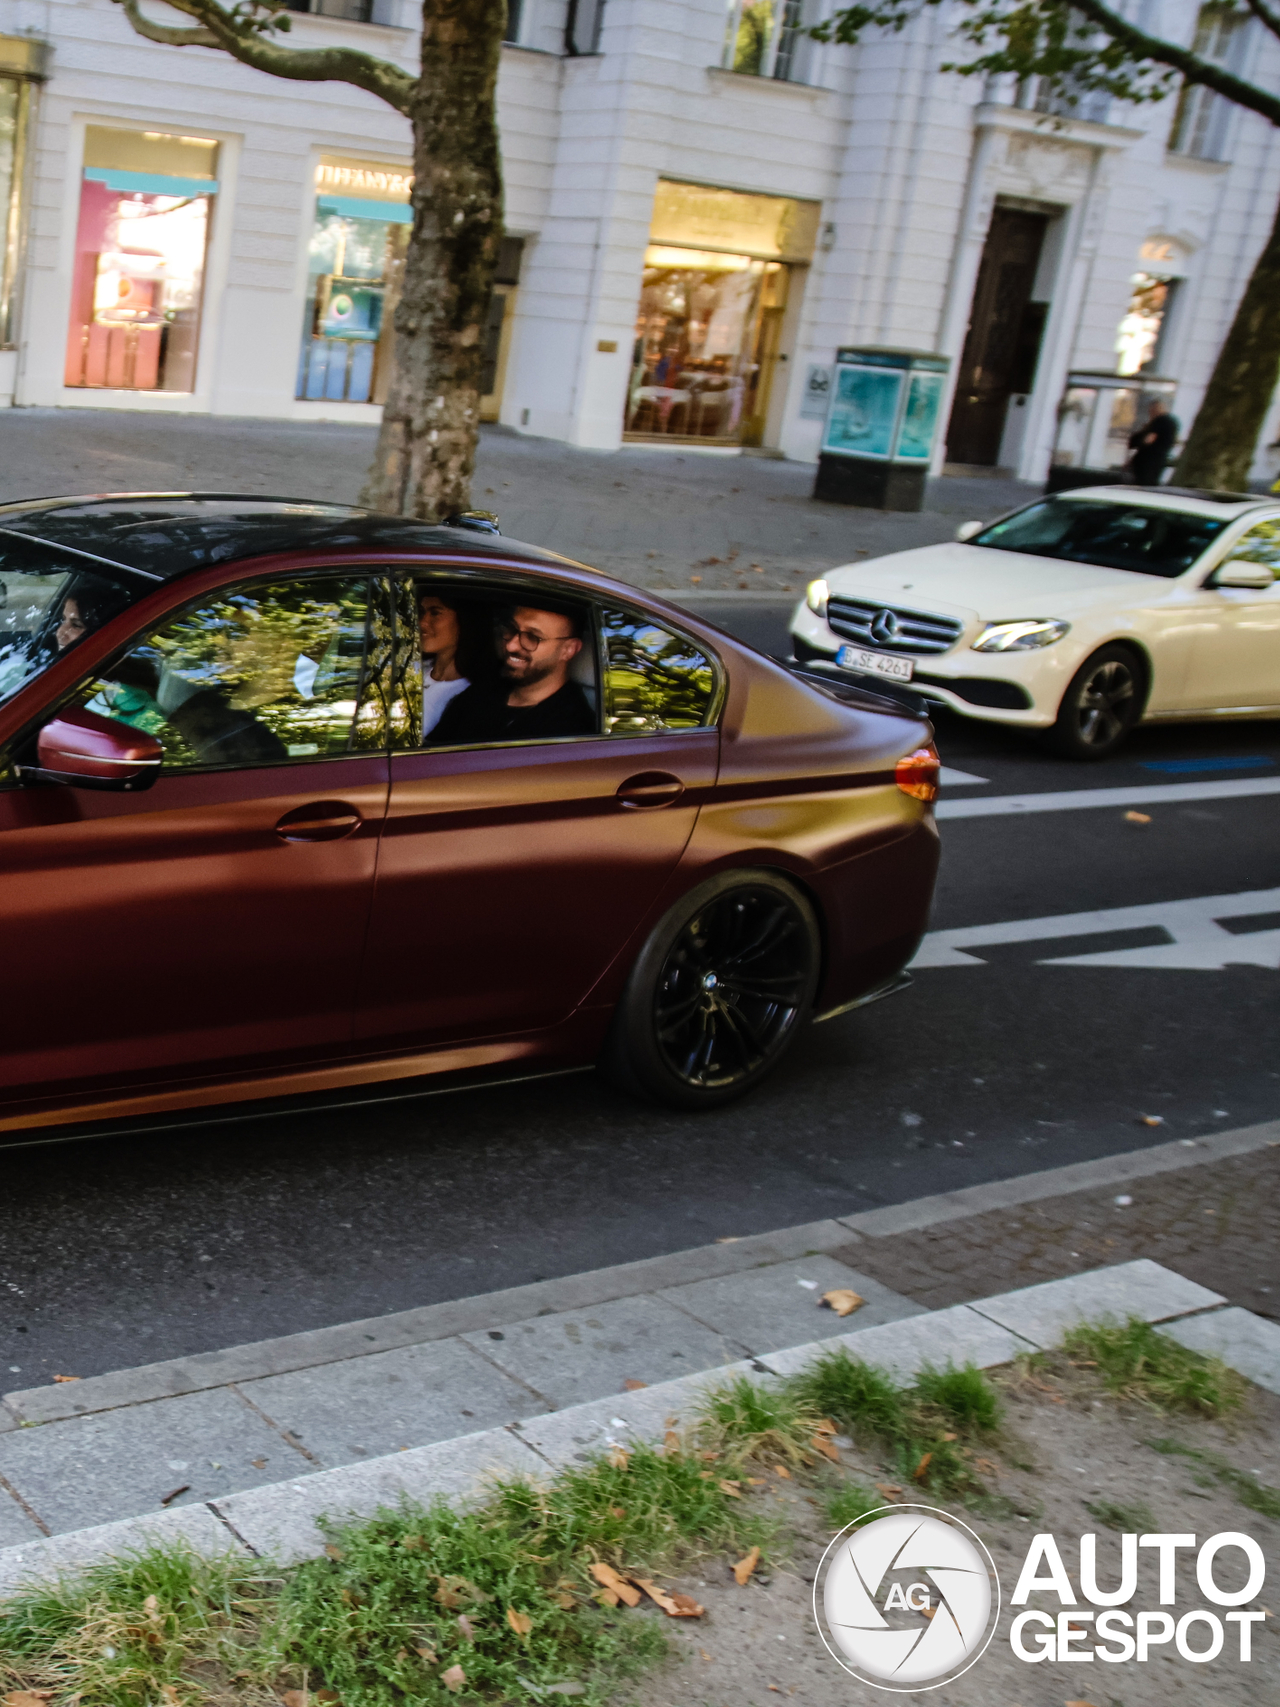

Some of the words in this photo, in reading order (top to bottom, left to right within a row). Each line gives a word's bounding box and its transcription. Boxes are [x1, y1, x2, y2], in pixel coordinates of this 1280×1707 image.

[843, 648, 852, 664] B
[859, 652, 874, 669] SE
[877, 657, 909, 677] 4261
